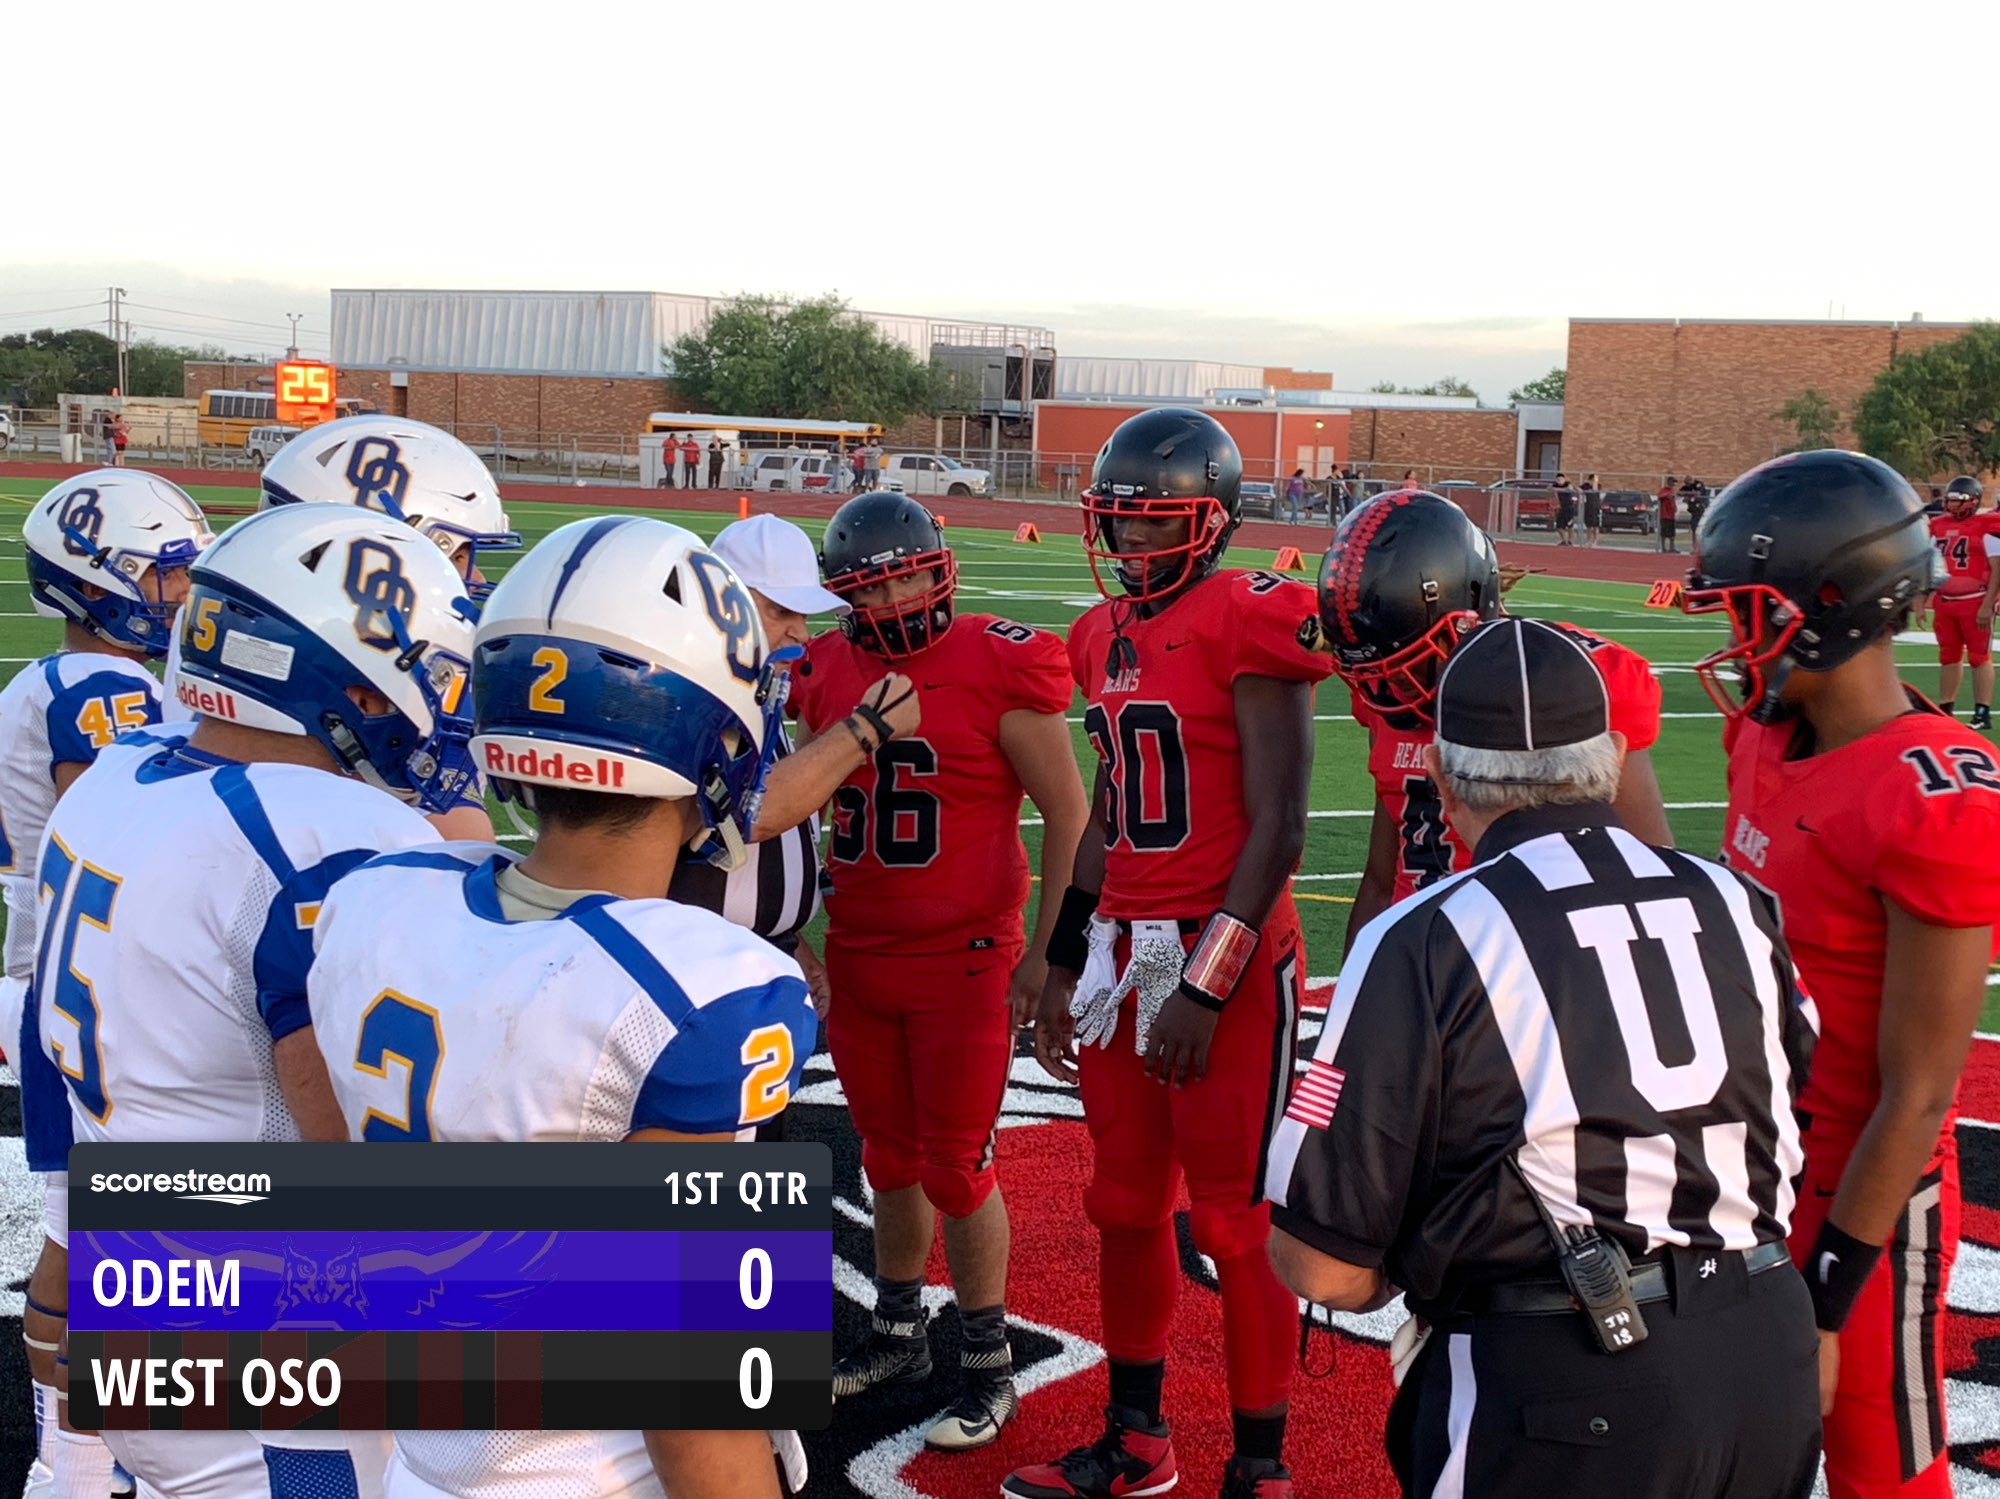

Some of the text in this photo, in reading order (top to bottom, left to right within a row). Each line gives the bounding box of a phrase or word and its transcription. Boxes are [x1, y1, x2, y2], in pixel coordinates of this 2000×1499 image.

[283, 366, 329, 403] 25
[1648, 582, 1671, 604] 20
[177, 680, 236, 720] ddell
[529, 646, 568, 714] 2
[76, 691, 150, 749] 45
[485, 742, 624, 788] Riddell
[1899, 744, 2000, 797] 12
[975, 940, 987, 948] XL
[1566, 897, 1728, 1113] U
[738, 1022, 795, 1125] 2
